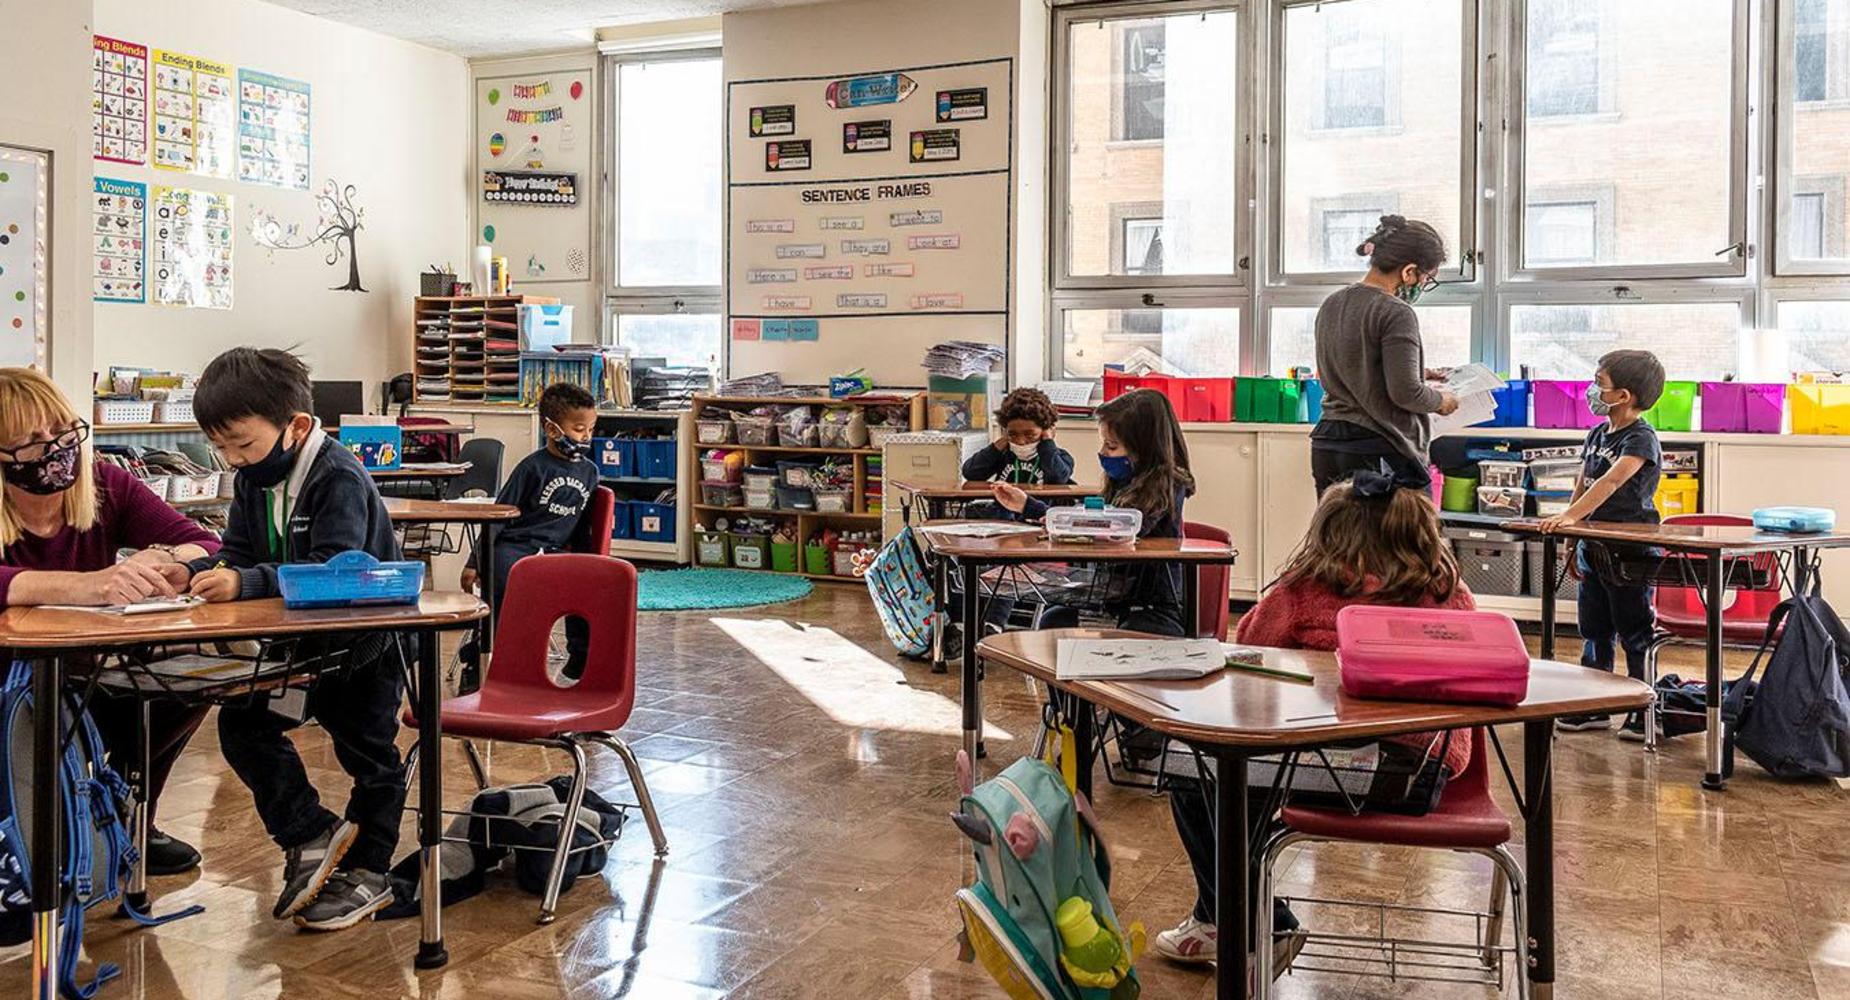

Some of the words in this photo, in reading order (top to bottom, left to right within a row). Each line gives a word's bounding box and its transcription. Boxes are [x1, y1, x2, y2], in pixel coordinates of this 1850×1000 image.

[112, 41, 145, 57] Blends
[162, 53, 193, 68] Ending
[196, 60, 225, 74] Blends
[99, 181, 141, 196] Vowels
[802, 188, 871, 202] SENTENCE
[878, 182, 931, 198] FRAMES
[158, 207, 169, 218] a
[159, 228, 169, 239] e
[790, 249, 806, 257] can
[158, 268, 169, 280] o
[774, 298, 796, 308] have
[925, 296, 946, 308] love
